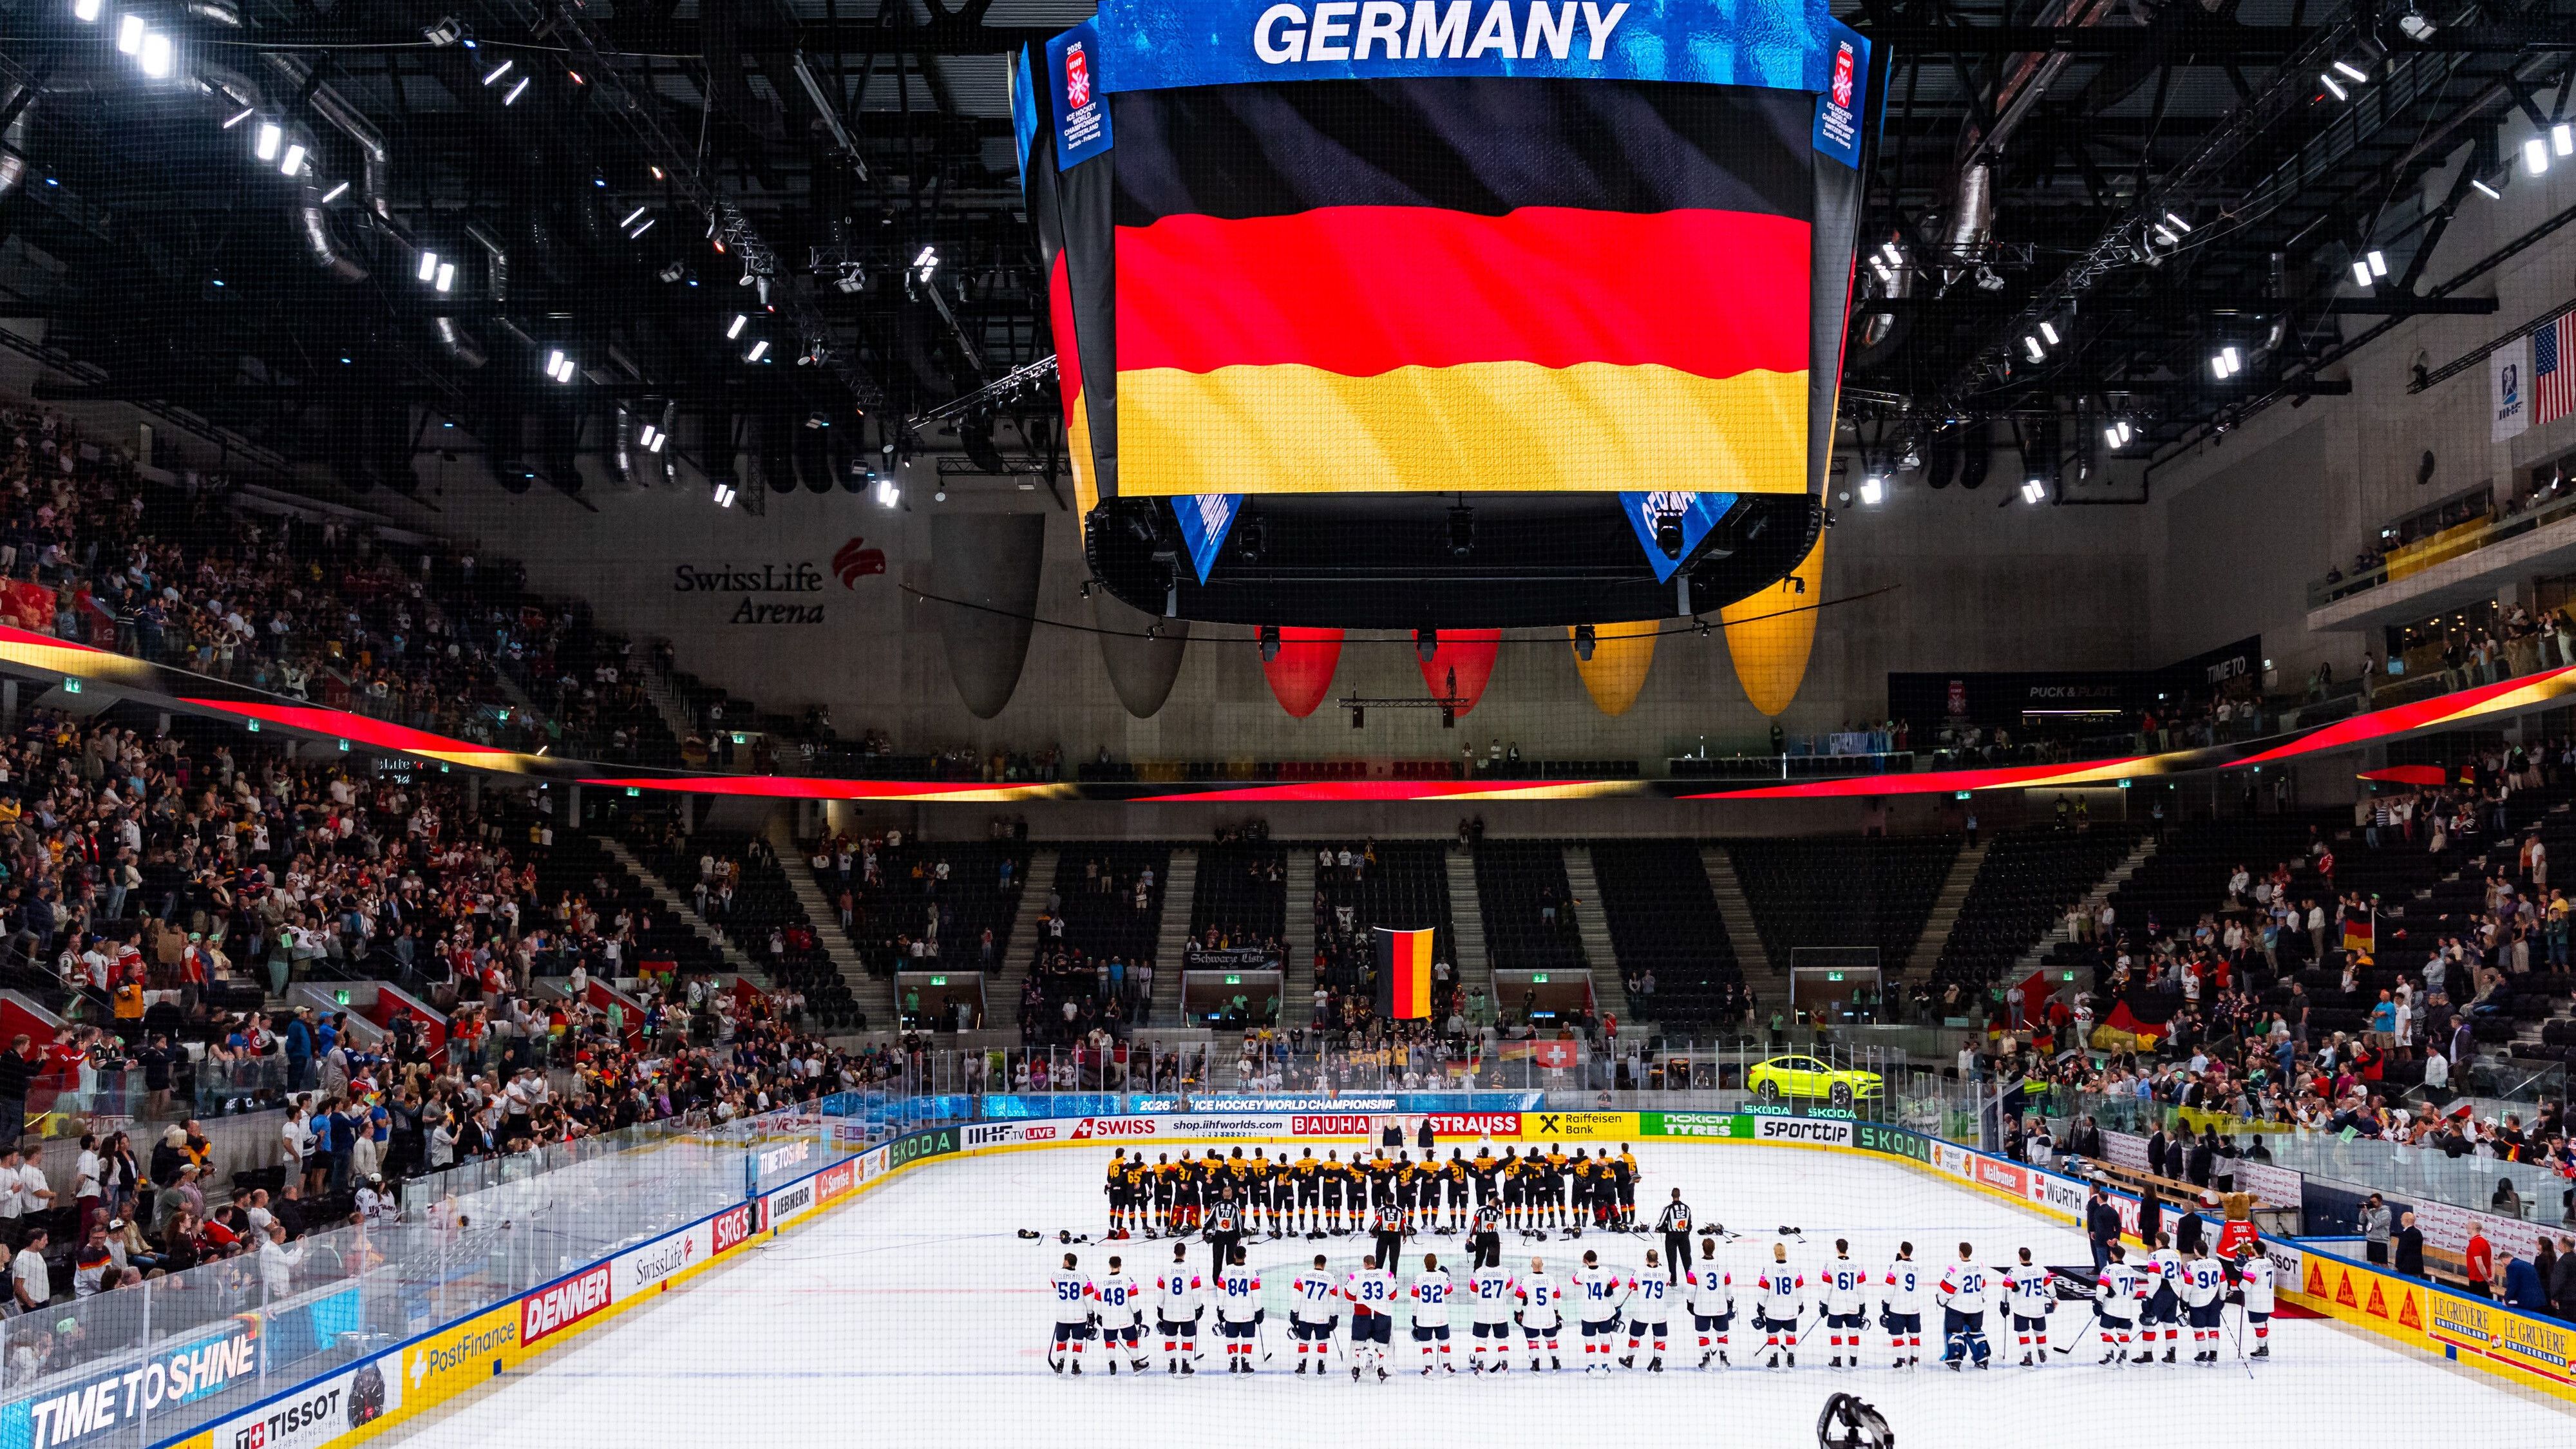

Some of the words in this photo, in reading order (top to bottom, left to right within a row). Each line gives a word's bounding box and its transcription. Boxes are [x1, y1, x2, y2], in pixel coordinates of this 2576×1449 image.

[1254, 0, 1630, 65] GERMANY
[1067, 41, 1082, 55] 2026
[1069, 57, 1083, 70] IIHF
[1066, 111, 1075, 122] ICE
[1075, 102, 1096, 119] HOCKEY
[1073, 113, 1092, 126] WORLD
[1826, 101, 1835, 112] ICE
[1834, 106, 1853, 120] HOCKEY
[1831, 111, 1847, 124] WORLD
[1064, 114, 1101, 137] CHAMPIONSHIP
[2499, 401, 2523, 421] IIHF
[730, 596, 825, 624] Arena
[2207, 659, 2231, 685] TIME
[2231, 656, 2246, 677] TO
[2030, 687, 2065, 697] PUCK
[2067, 687, 2076, 697] &
[2078, 687, 2117, 697] PLATE
[1191, 953, 1238, 965] Schwarze
[1242, 953, 1265, 963] Liste
[1140, 1101, 1170, 1111] 2026
[1195, 1101, 1215, 1111] ICE
[1215, 1100, 1264, 1111] HOCKEY
[1264, 1100, 1307, 1110] WORLD
[1308, 1099, 1396, 1110] CHAMPIONSHIP
[1097, 1119, 1155, 1135] SWISS
[1173, 1120, 1282, 1131] shop.iihfworlds.com
[1293, 1117, 1383, 1133] BAUHAU
[1430, 1115, 1517, 1132] STRAUSS
[1566, 1113, 1622, 1124] Raiffeisen
[1027, 1128, 1055, 1139] LIVE
[1566, 1124, 1593, 1134] Bank
[1663, 1124, 1731, 1136] TYRES
[828, 1168, 849, 1193] Sunrise
[1128, 1170, 1142, 1184] 65
[1505, 1164, 1520, 1179] 64
[1576, 1165, 1589, 1178] 95
[1984, 1162, 2017, 1188] Malbuner
[773, 1186, 810, 1218] LIEBHERR
[1220, 1209, 1230, 1217] 70
[1388, 1213, 1395, 1221] 15
[1172, 1277, 1182, 1295] 8
[1227, 1278, 1248, 1297] 84
[1481, 1280, 1504, 1298] 27
[1642, 1280, 1664, 1299] 79
[1706, 1272, 1717, 1291] 3
[1775, 1276, 1792, 1295] 18
[1838, 1272, 1854, 1290] 61
[1905, 1273, 1915, 1292] 9
[1963, 1274, 1982, 1293] 20
[2020, 1277, 2042, 1297] 75
[2198, 1271, 2218, 1289] 94
[2266, 1271, 2273, 1289] 7
[1058, 1282, 1080, 1300] 58
[1104, 1287, 1124, 1306] 48
[1305, 1280, 1328, 1301] 77
[1362, 1281, 1383, 1300] 33
[1421, 1284, 1443, 1303] 92
[1536, 1287, 1547, 1306] 5
[1586, 1282, 1602, 1300] 14
[2339, 1279, 2354, 1304] Sika
[524, 1267, 609, 1341] DENNER
[2369, 1289, 2387, 1315] Sika
[2400, 1299, 2420, 1325] Sika
[2434, 1296, 2444, 1316] LE
[2446, 1300, 2488, 1331] GRUYÈRE
[2436, 1318, 2487, 1340] SWITZERLAND
[2505, 1317, 2516, 1339] LE
[2518, 1322, 2566, 1355] GRUYÈRE
[430, 1320, 515, 1377] PostFinance
[2506, 1341, 2564, 1366] SWITZERLAND
[32, 1377, 119, 1449] TIME
[122, 1363, 166, 1418] TO
[167, 1334, 254, 1400] SHINE
[268, 1388, 340, 1442] TISSOT
